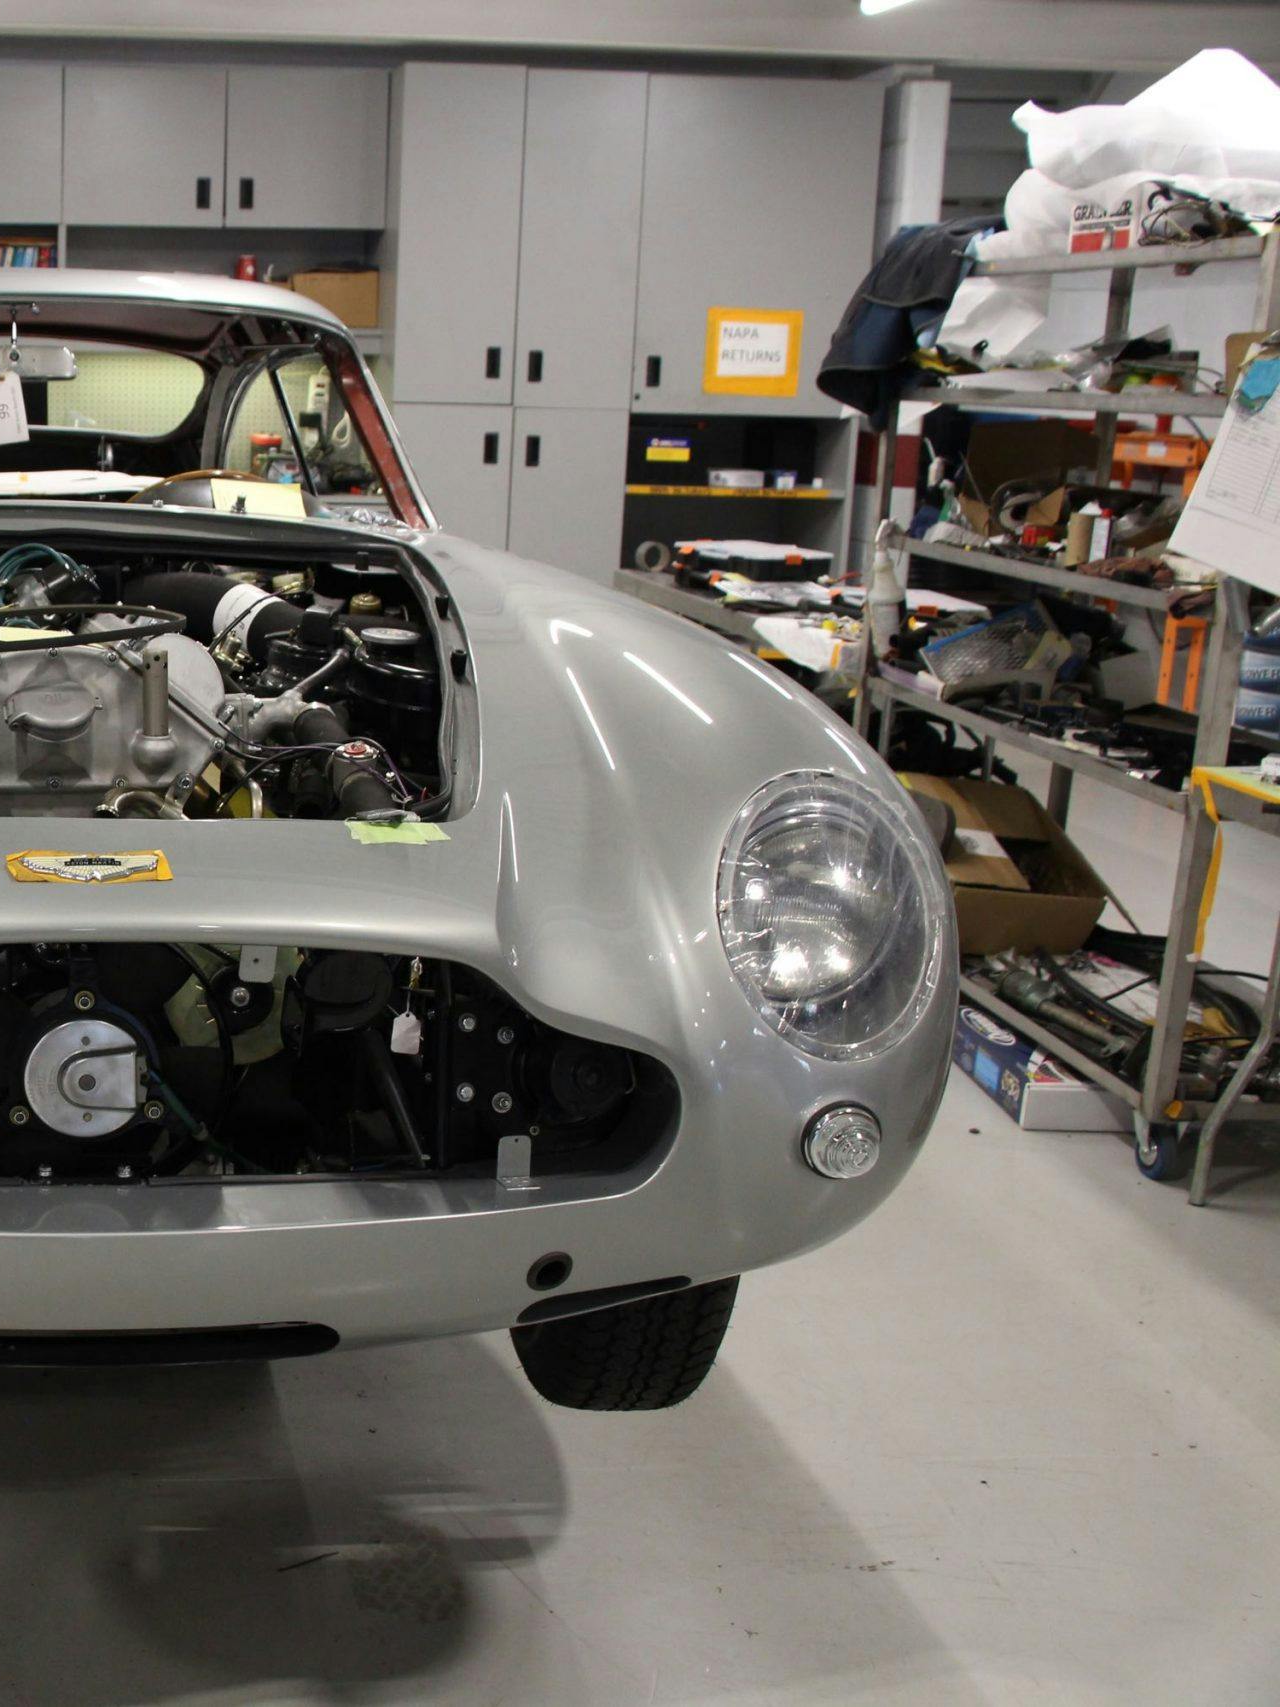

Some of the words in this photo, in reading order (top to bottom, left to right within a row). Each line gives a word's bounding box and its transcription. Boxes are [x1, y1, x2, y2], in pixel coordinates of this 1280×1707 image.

[1073, 200, 1133, 221] GRAR
[723, 326, 759, 338] NAPA
[722, 349, 781, 362] RETURNS
[1245, 667, 1280, 679] OWER
[1238, 704, 1277, 718] OWER
